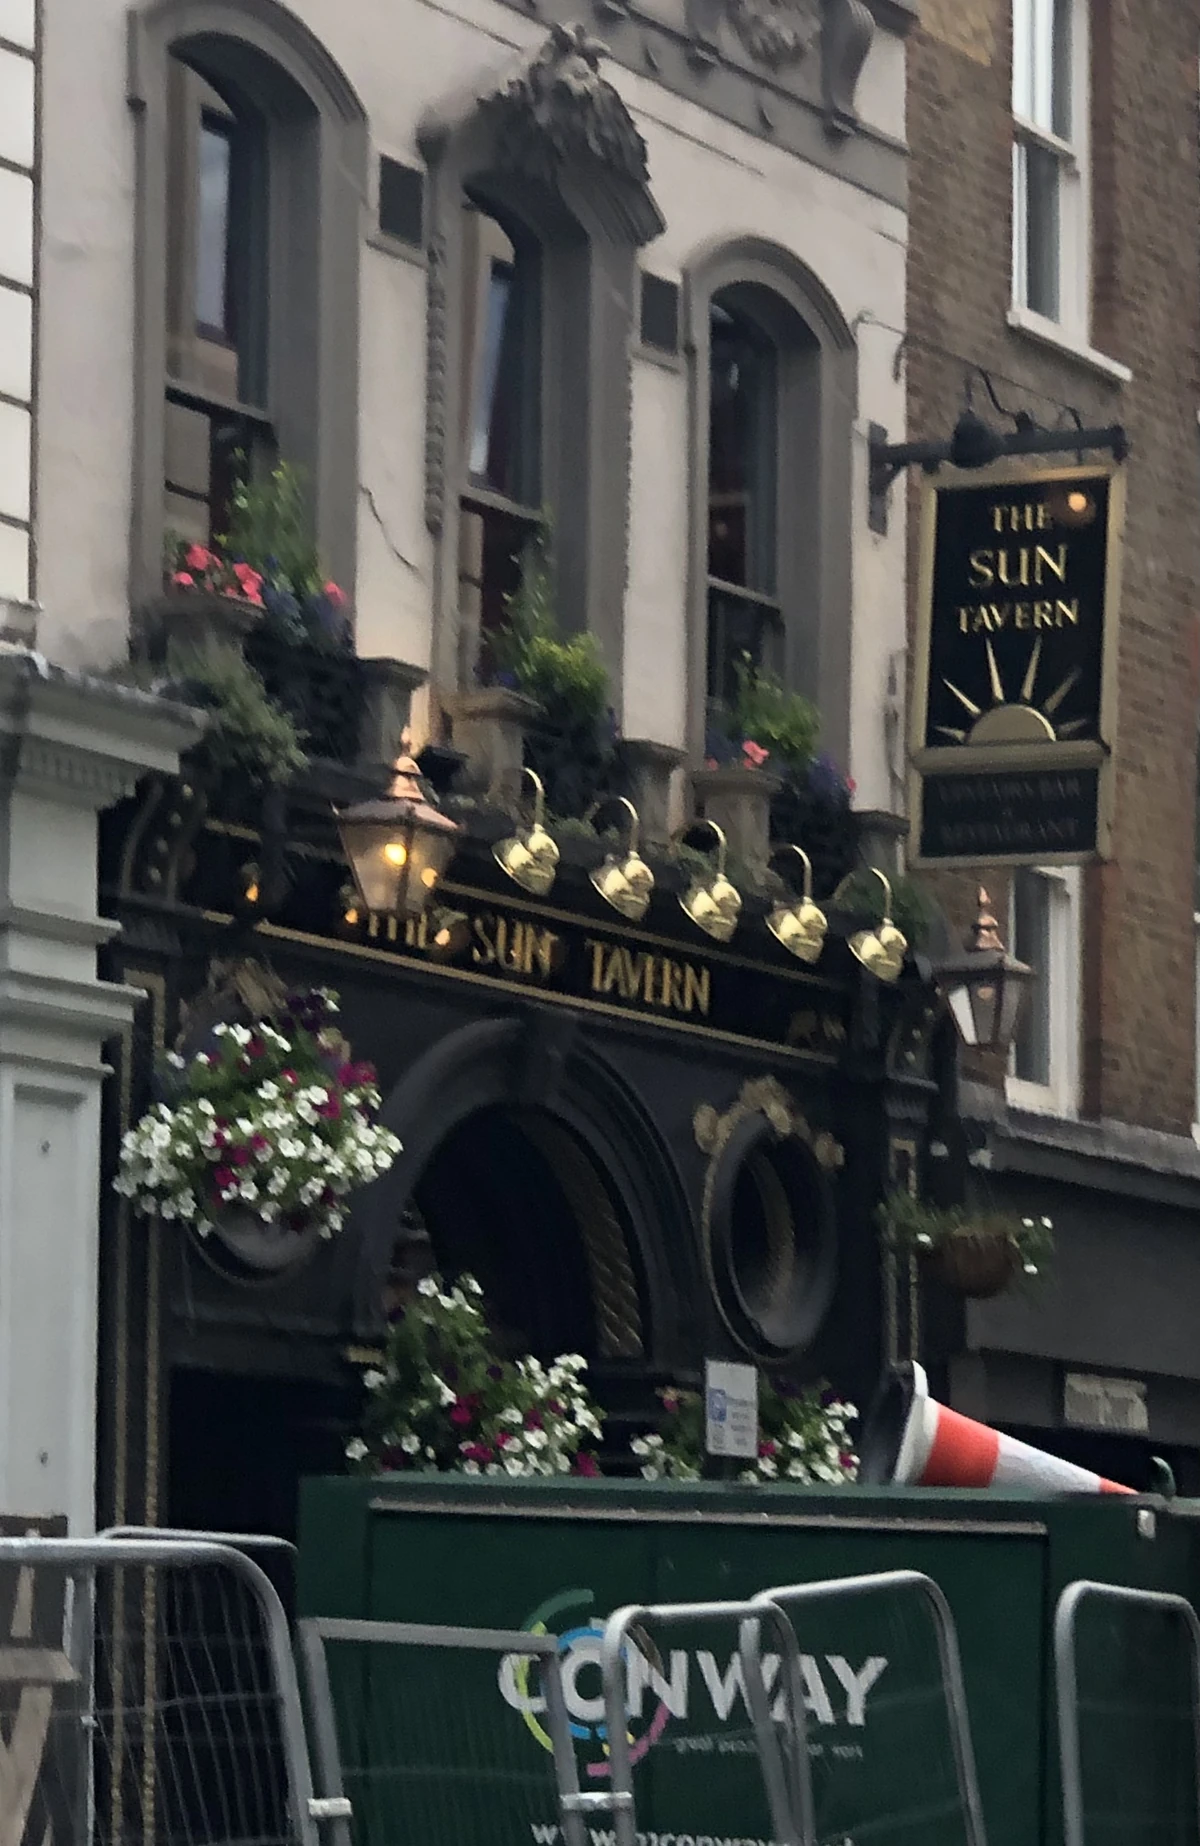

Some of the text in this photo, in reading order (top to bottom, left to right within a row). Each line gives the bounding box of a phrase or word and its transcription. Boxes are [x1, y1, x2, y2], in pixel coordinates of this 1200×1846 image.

[990, 503, 1053, 533] THE
[968, 542, 1068, 588] SUN
[956, 597, 1079, 633] TAVERN
[471, 914, 560, 978] SUN
[584, 936, 712, 1017] TAVERN
[498, 1647, 889, 1726] CONWAY
